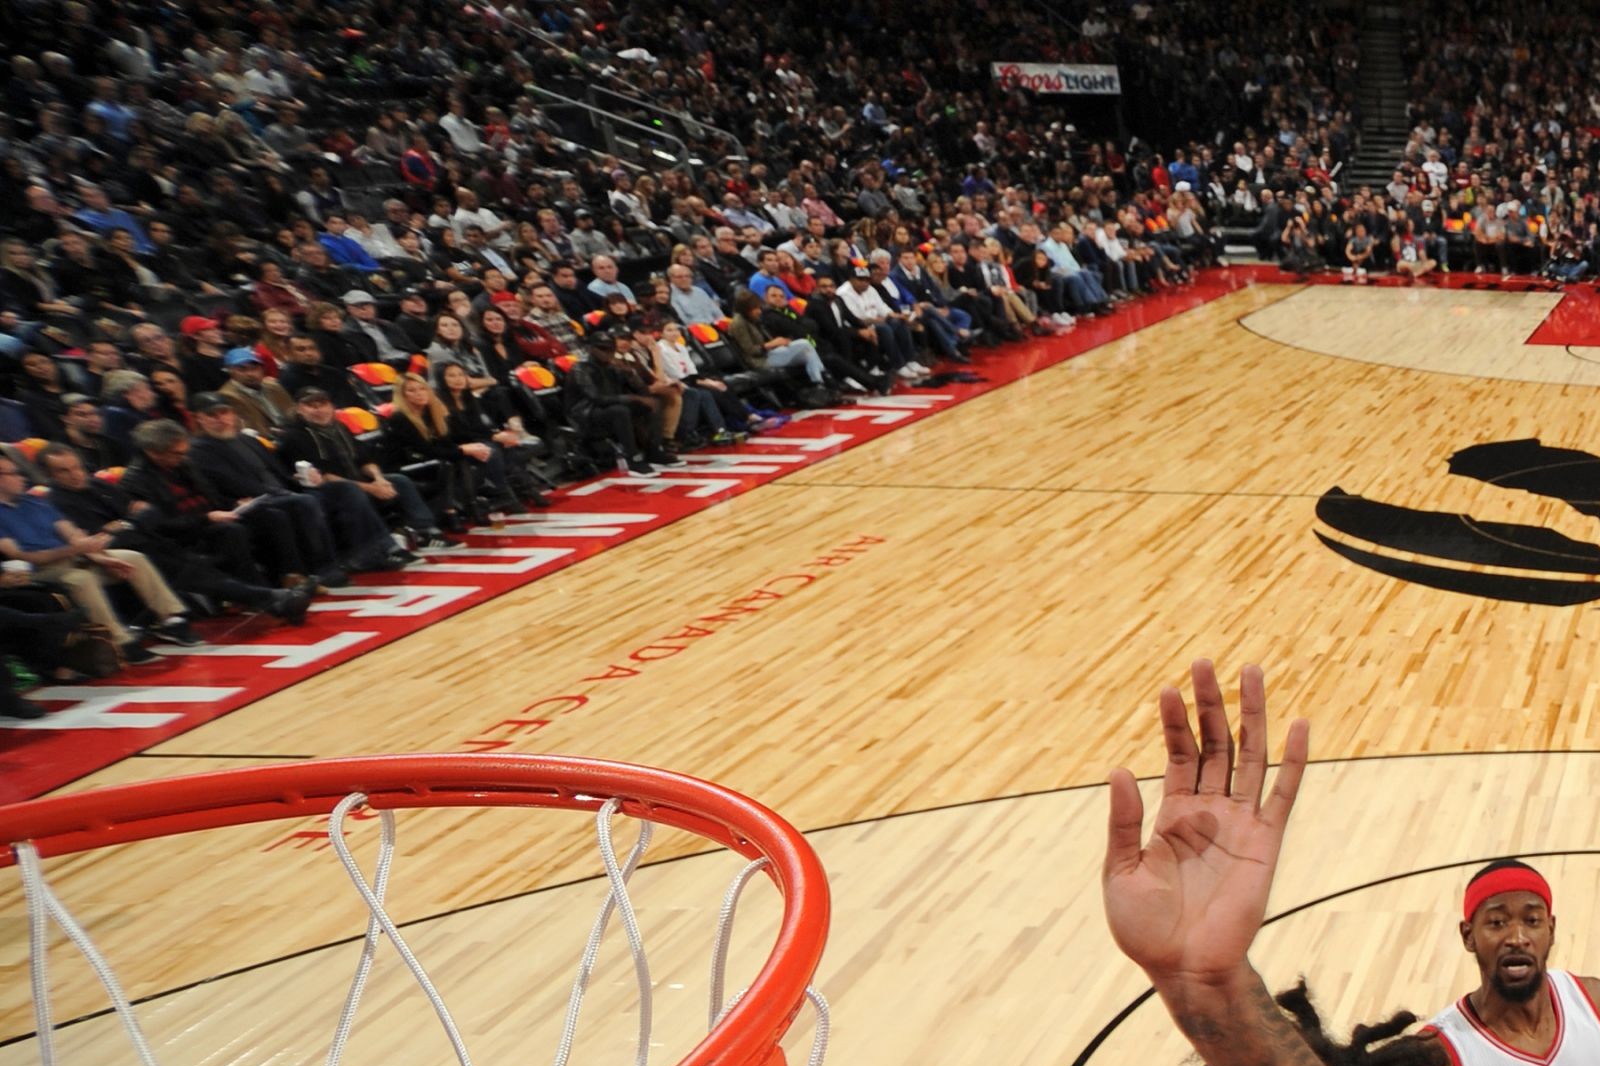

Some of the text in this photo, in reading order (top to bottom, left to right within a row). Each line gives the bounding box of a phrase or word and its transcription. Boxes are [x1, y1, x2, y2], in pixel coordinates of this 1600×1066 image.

[999, 64, 1116, 91] Coors LIGHT
[800, 535, 886, 568] AIR
[0, 512, 660, 730] NORTH
[578, 573, 817, 682] CANADA
